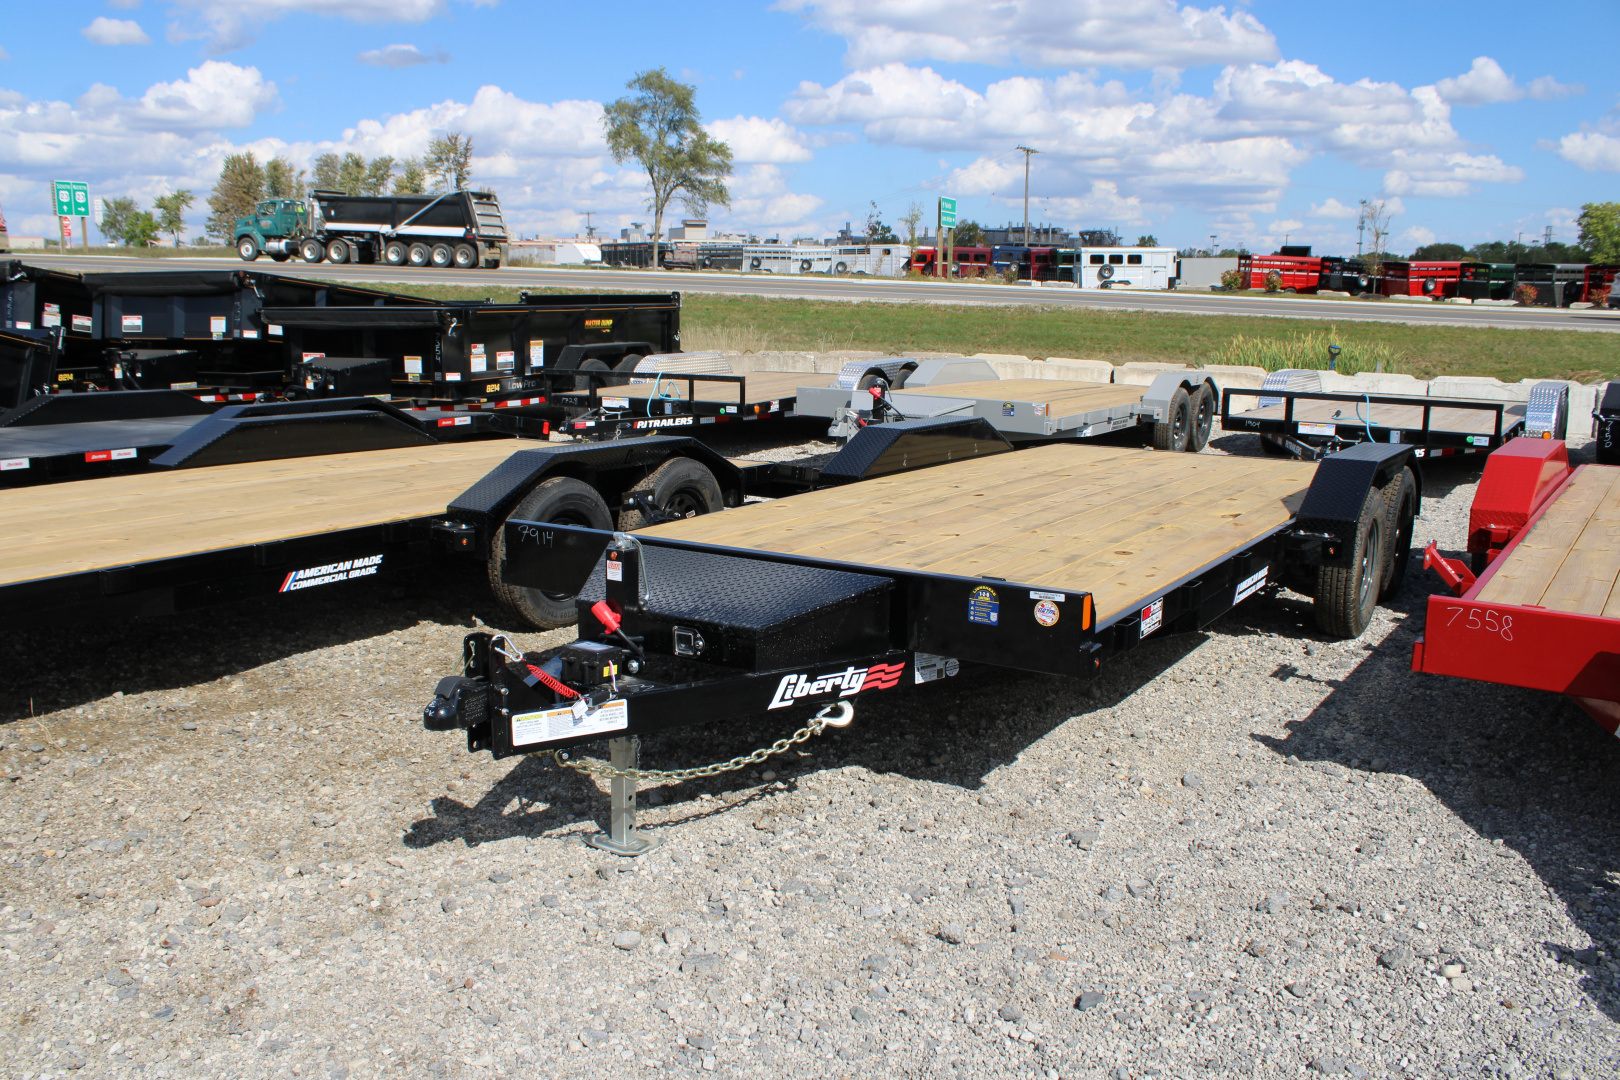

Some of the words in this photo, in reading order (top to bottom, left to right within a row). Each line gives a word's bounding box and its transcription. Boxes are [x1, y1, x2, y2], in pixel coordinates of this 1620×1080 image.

[486, 383, 500, 393] 8214
[648, 417, 693, 428] TRAILERS
[518, 524, 554, 549] 7914
[290, 572, 348, 591] COMMERCIAL
[348, 565, 378, 579] GRADE
[295, 560, 353, 580] AMERICAN
[352, 554, 384, 569] MADE
[1446, 606, 1513, 642] 7558
[767, 666, 869, 710] Liberty
